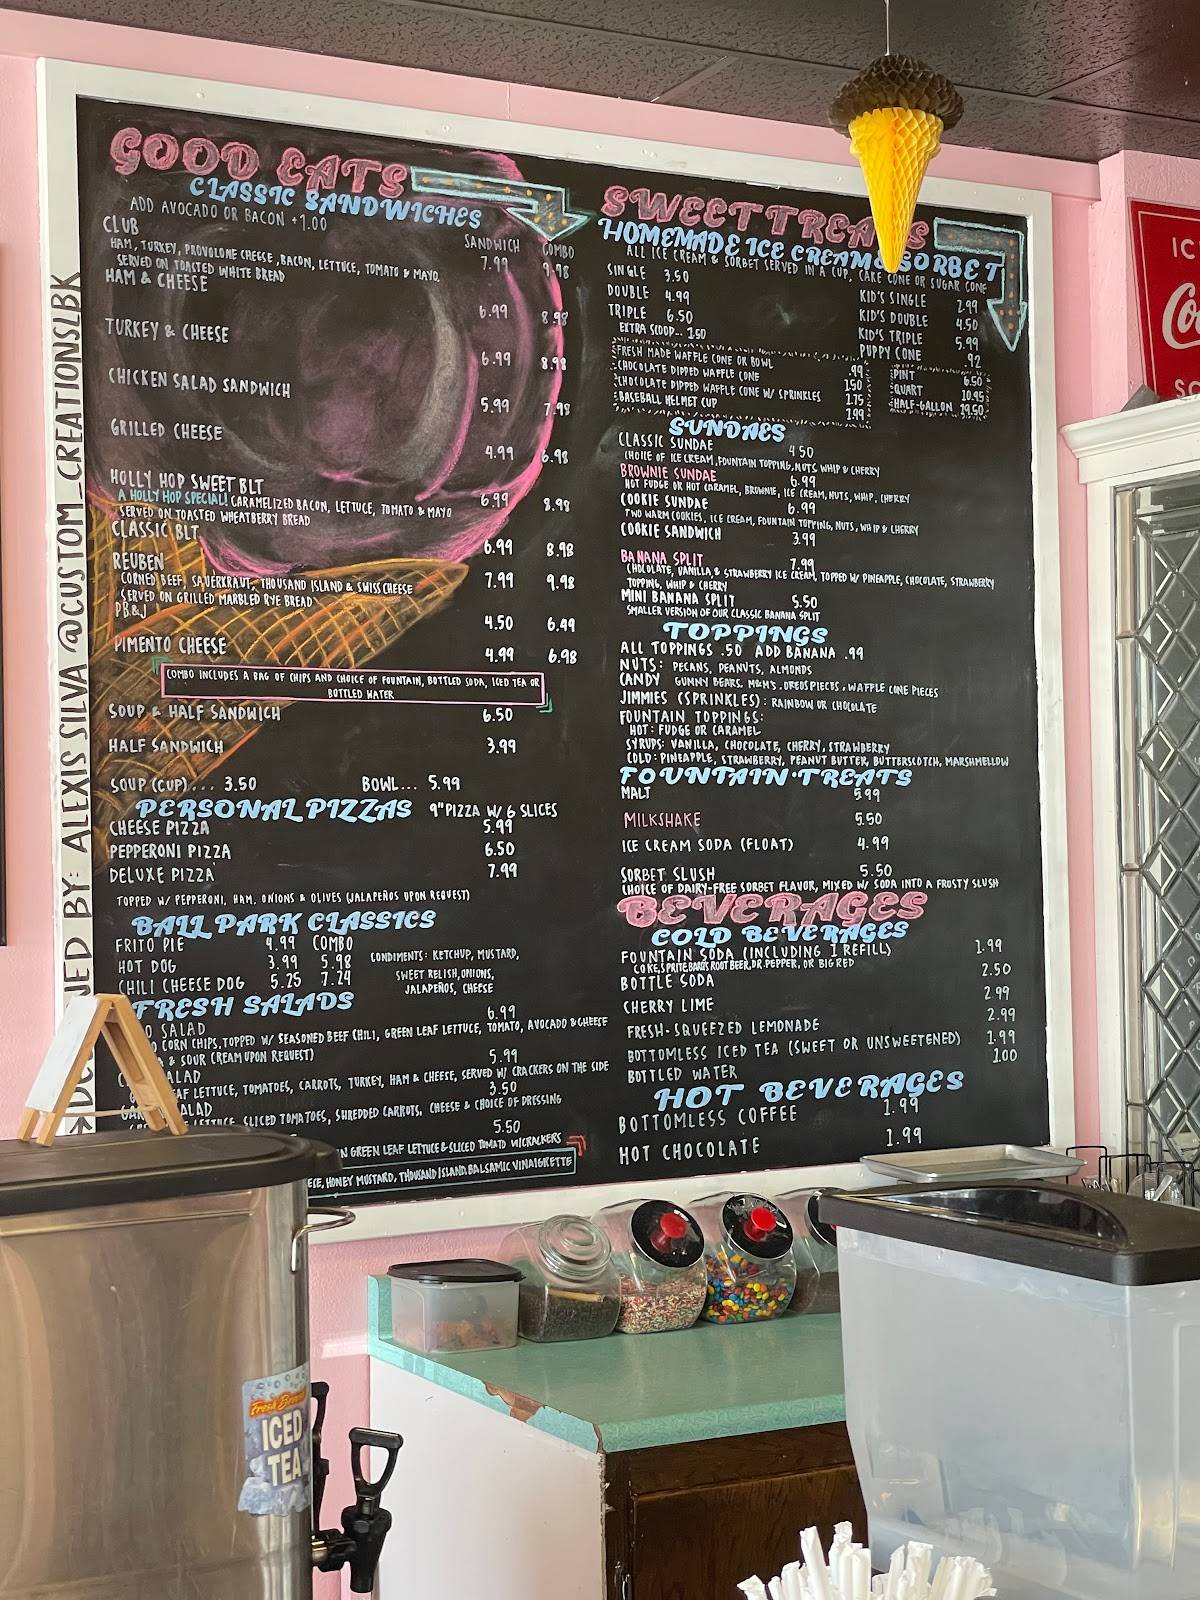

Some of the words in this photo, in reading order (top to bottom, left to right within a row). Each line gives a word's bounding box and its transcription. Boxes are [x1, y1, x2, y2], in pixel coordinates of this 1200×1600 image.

[110, 127, 260, 181] GOOD
[276, 147, 407, 198] EATS
[130, 197, 154, 213] ADD
[162, 200, 218, 218] AVOCADO
[223, 207, 238, 222] OR
[245, 209, 285, 226] BACON
[190, 177, 295, 206] CLASSIC
[305, 190, 482, 230] SANDWICHES
[103, 216, 139, 236] CLUB
[601, 185, 764, 231] SWEET
[765, 204, 930, 249] TREAS
[464, 234, 520, 252] SANDWICH
[542, 243, 575, 259] COMBO
[598, 218, 740, 256] HOMEMADE
[746, 237, 785, 260] ICE
[791, 245, 872, 270] CREAM
[480, 256, 509, 273] 7.99
[607, 263, 646, 280] SINGLE
[664, 269, 689, 283] 3.50
[105, 269, 136, 285] HAM
[140, 273, 151, 284] &
[157, 273, 208, 292] CHEESE
[607, 284, 649, 299] DOUBLE
[665, 290, 690, 305] 4.99
[859, 289, 884, 304] KID'S
[890, 292, 926, 308] SINGLE
[957, 300, 978, 314] 2.99
[479, 305, 508, 319] 6.99
[608, 303, 646, 319] TRIPLE
[667, 309, 693, 324] 6.50
[105, 318, 159, 341] TURKEY
[164, 324, 176, 337] &
[182, 323, 230, 344] CHEESE
[481, 351, 511, 367] 6.99
[617, 345, 642, 357] FRESH
[648, 346, 671, 359] MADE
[674, 349, 708, 363] WAFFLE
[712, 354, 732, 365] CONE
[737, 356, 747, 366] OR
[751, 357, 774, 369] BOWL
[108, 367, 168, 388] CHICKEN
[173, 373, 217, 393] SALAD
[222, 378, 291, 398] SANDWICH
[893, 369, 915, 381] PINT
[963, 375, 983, 387] 6.50
[480, 397, 510, 414] 5.99
[619, 391, 662, 405] BASEBALL
[665, 396, 697, 407] HELMET
[701, 397, 718, 408] CUP
[893, 398, 953, 412] HALF-GALLON
[619, 431, 664, 448] CLASSIC
[671, 436, 713, 451] SUNDAE
[111, 469, 152, 488] HOLLY
[159, 472, 185, 489] HOP
[191, 474, 236, 493] SWEET
[239, 477, 264, 495] BLT
[620, 463, 668, 478] BROWNIE
[674, 467, 717, 482] SUNDAE
[790, 476, 816, 488] 6.99
[621, 492, 659, 506] COOKIE
[665, 496, 708, 509] SUNDAE
[787, 502, 816, 515] 6.99
[111, 520, 169, 538] CLASSIC
[175, 524, 199, 540] BLT
[112, 551, 165, 572] REUBEN
[621, 549, 667, 564] BANANA
[673, 552, 704, 566] SPLIT
[485, 572, 515, 589] 7.99
[547, 574, 575, 592] 9.98
[663, 622, 828, 647] TOPPINGS
[114, 635, 172, 653] PIMENTO
[178, 636, 227, 655] CHEESE
[620, 641, 643, 654] ALL
[651, 642, 713, 656] TOPPINGS
[721, 644, 742, 656] .50
[485, 647, 515, 664] 4.99
[770, 665, 812, 675] ALMONDS
[59, 663, 88, 740] SILVA
[620, 691, 667, 705] JIMMIES
[108, 703, 145, 719] SOUP
[169, 704, 204, 721] HALF
[211, 704, 281, 721] SANDWICH
[482, 707, 514, 723] 6.50
[620, 766, 789, 787] FOUNTAIN
[797, 768, 913, 788] TREATS
[60, 750, 90, 853] ALEXIS
[621, 786, 651, 799] MALT
[136, 798, 303, 823] PERSONAL
[305, 797, 413, 824] PIZZAS
[624, 812, 701, 828] MILKSHAKE
[109, 820, 160, 836] CHEESE
[166, 821, 209, 836] PIZZA
[483, 819, 513, 834] 5.99
[110, 844, 181, 860] PEPPERONI
[188, 844, 232, 860] PIZZA
[485, 841, 515, 857] 6.50
[622, 839, 638, 852] ICE
[646, 839, 691, 852] CREAM
[698, 838, 732, 851] SODA
[741, 837, 794, 851] (FLOAT)
[857, 836, 889, 851] 4.99
[621, 867, 666, 882] SORBET
[673, 867, 715, 881] SLUSH
[860, 864, 892, 877] 5.50
[617, 890, 928, 928] BEVERAGES
[131, 915, 212, 939] BALL
[214, 912, 303, 936] PARK
[307, 910, 437, 936] CLASSICS
[651, 928, 731, 948] COLD
[742, 921, 909, 944] BEVERAGES
[115, 938, 155, 953] FRITO
[163, 937, 185, 952] PIE
[266, 936, 296, 951] 4.99
[975, 939, 1002, 954] 1.99
[621, 948, 692, 964] FOUNTAIN
[700, 948, 733, 961] SODA
[118, 959, 143, 974] HOT
[151, 959, 176, 973] DOG
[118, 980, 155, 995] CHILI
[163, 977, 211, 993] CHEESE
[217, 976, 245, 990] DOG
[132, 997, 235, 1021] FRESH
[243, 992, 355, 1017] SALADS
[623, 999, 673, 1015] CHERRY
[681, 998, 714, 1012] LIME
[752, 1018, 819, 1035] LEMONADE
[489, 1049, 518, 1065] 5.99
[628, 1046, 707, 1063] BOTTOMLESS
[718, 1045, 746, 1058] ICED
[755, 1042, 779, 1056] TEA
[788, 1039, 835, 1056] (SWEET
[843, 1036, 858, 1050] OR
[867, 1031, 961, 1049] UNSWEETENED)
[628, 1067, 683, 1084] BOTTLED
[693, 1065, 737, 1080] WATER
[654, 1084, 744, 1112] HOT
[758, 1069, 964, 1103] BEVERAGES
[619, 1109, 726, 1134] BOTTOMLESS
[739, 1104, 797, 1125] COFFEE
[884, 1097, 919, 1116] 1.99
[619, 1145, 649, 1165] HOT
[663, 1137, 760, 1160] CHOCOLATE
[887, 1127, 922, 1147] 1.99
[262, 1409, 303, 1451] ICED
[268, 1448, 302, 1486] TEA
